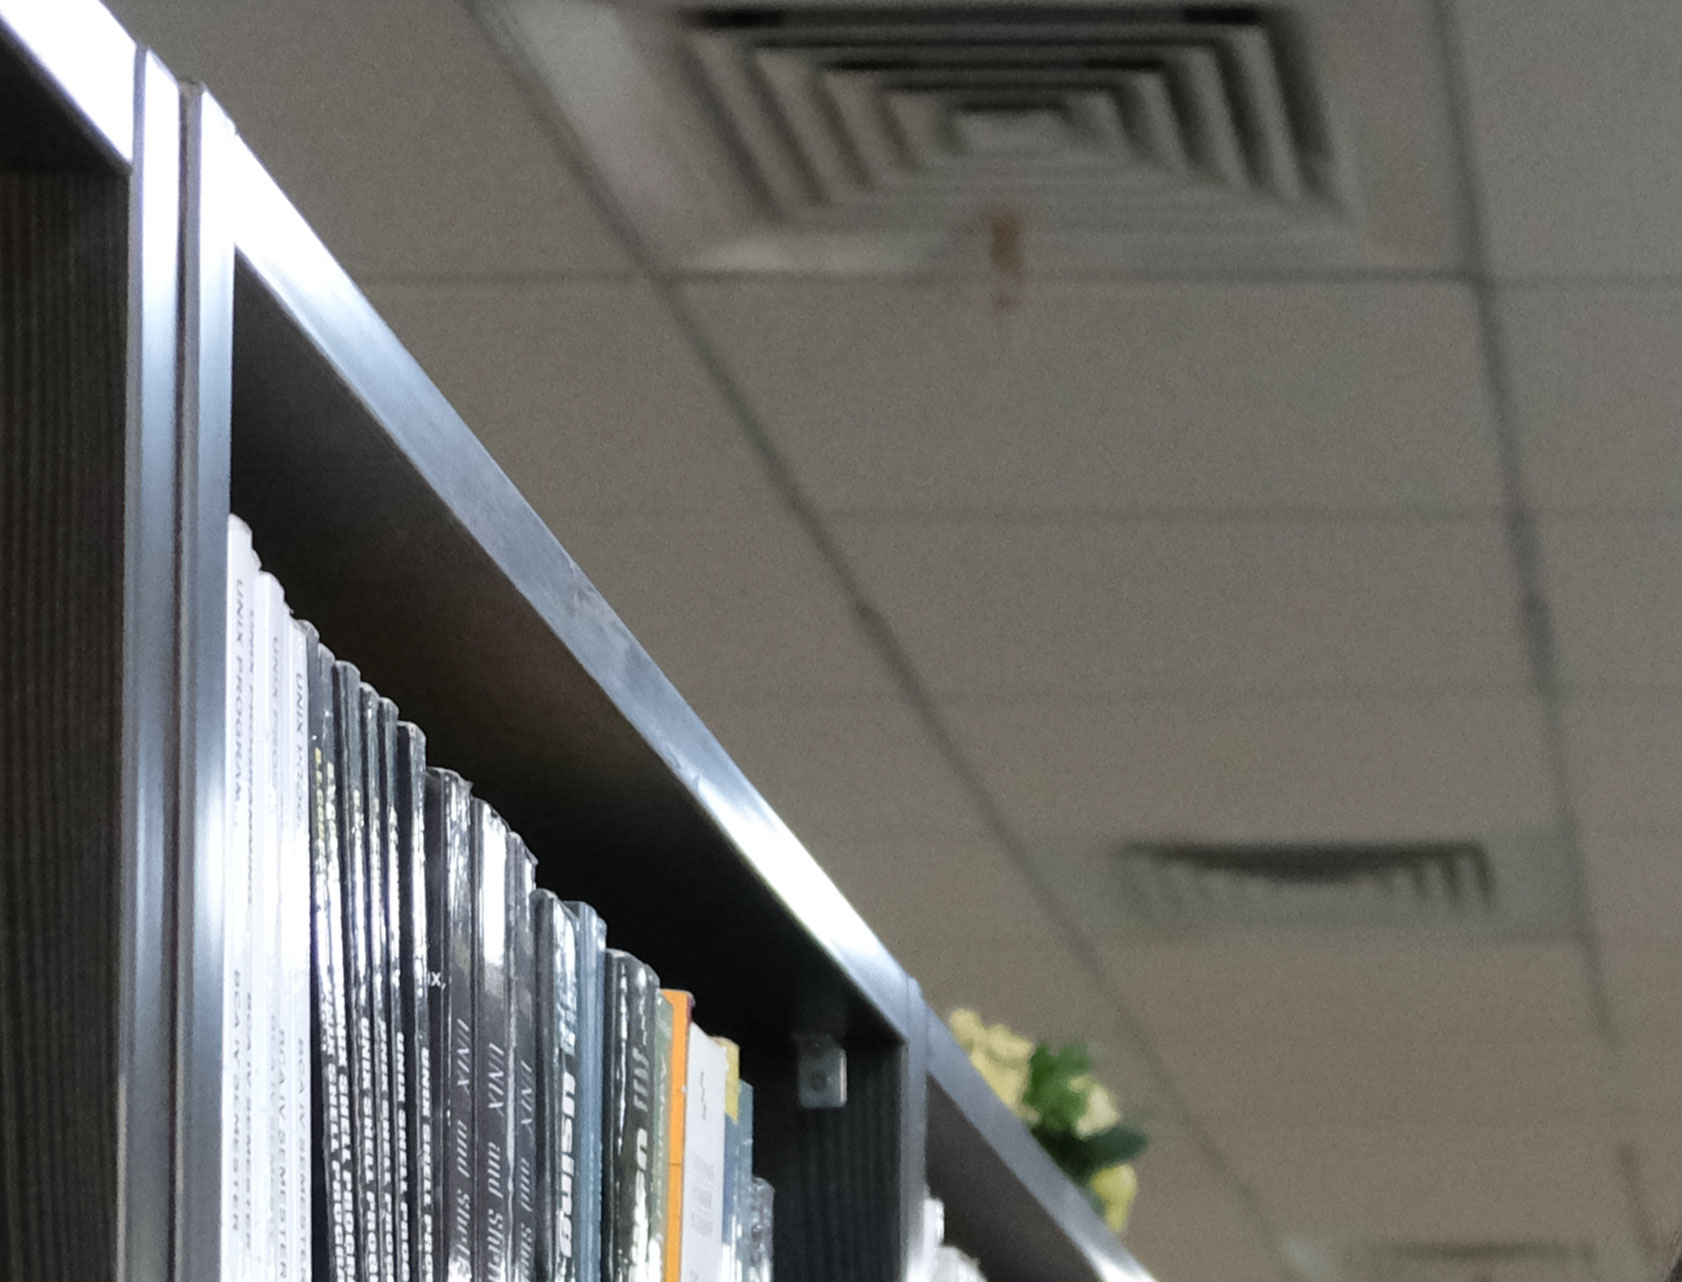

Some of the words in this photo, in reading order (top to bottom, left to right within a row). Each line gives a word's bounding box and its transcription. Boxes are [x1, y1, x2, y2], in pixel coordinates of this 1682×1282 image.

[361, 1017, 370, 1089] UNIX
[380, 1021, 388, 1092] UNIX
[397, 1032, 405, 1102] UNIX
[422, 1047, 430, 1117] UNIX
[457, 1019, 469, 1096] UNIX
[488, 1043, 504, 1117] UNIX
[329, 1063, 339, 1152] SHELL
[340, 1074, 350, 1163] SHELL
[521, 1060, 532, 1134] UNIX
[364, 1096, 374, 1184] SHELL
[383, 1099, 391, 1186] SHELL
[399, 1109, 407, 1194] SHELL
[423, 1124, 432, 1206] SHELL
[457, 1120, 470, 1178] and
[488, 1142, 503, 1199] and
[559, 1071, 575, 1258] Using
[521, 1158, 532, 1212] and
